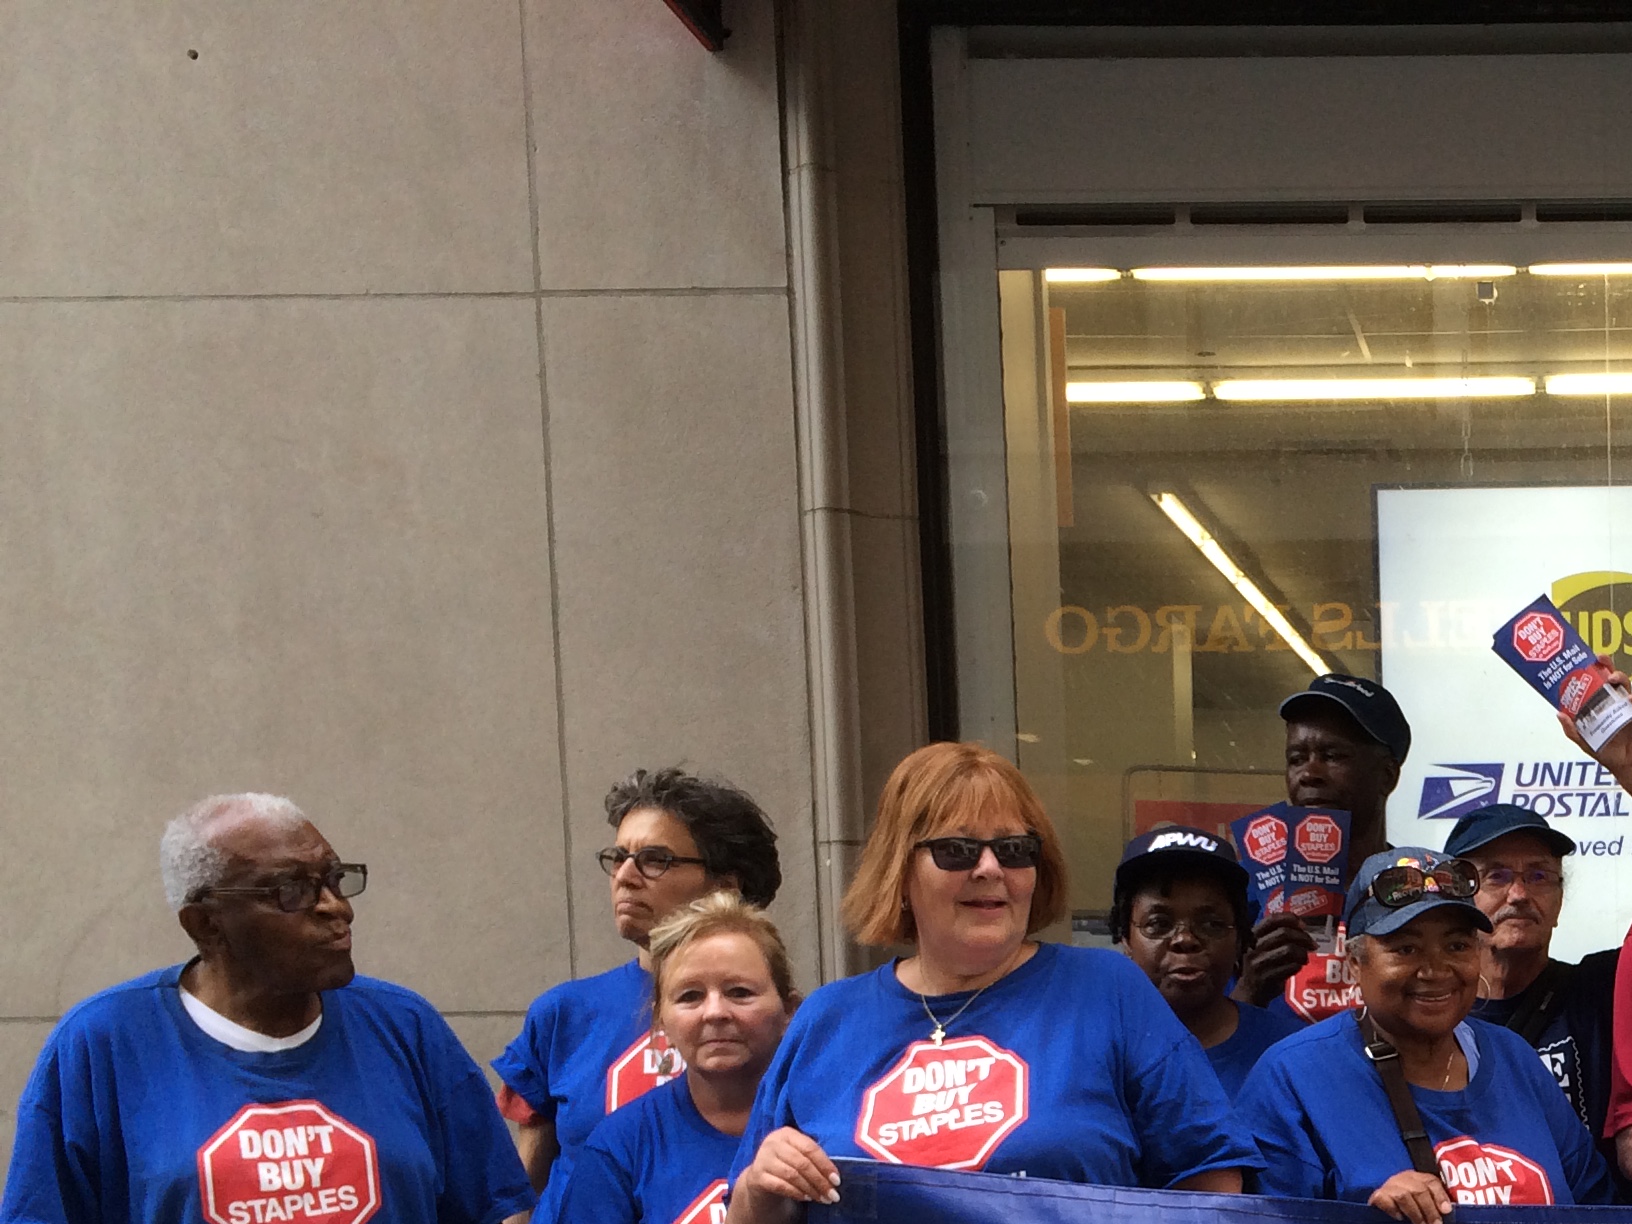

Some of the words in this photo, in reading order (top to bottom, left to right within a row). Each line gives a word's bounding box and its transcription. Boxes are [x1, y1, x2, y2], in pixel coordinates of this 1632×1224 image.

[1517, 616, 1544, 641] DON'T
[1528, 625, 1547, 645] BUY
[1528, 629, 1559, 659] STAPLES
[1538, 667, 1553, 681] The
[1550, 655, 1566, 671] U.S.
[1549, 667, 1565, 685] NOT
[1514, 761, 1618, 787] UNITE
[1510, 793, 1630, 818] POSTAL
[1252, 821, 1277, 838] DON'T
[1306, 821, 1333, 833] DON'T
[1309, 832, 1329, 843] BUY
[1147, 831, 1218, 853] APWU
[1258, 833, 1277, 847] BUY
[1300, 841, 1336, 852] STAPLES
[1255, 870, 1270, 881] The
[1290, 873, 1298, 882] Is
[1298, 873, 1315, 883] NOT
[1315, 875, 1325, 884] for
[1324, 875, 1340, 885] Sale
[1292, 863, 1307, 874] The
[1306, 864, 1321, 875] U.S.
[1323, 866, 1340, 876] Mail
[903, 1057, 996, 1094] DON'T
[912, 1083, 979, 1116] BUY
[878, 1101, 1005, 1146] STAPLES
[238, 1125, 334, 1160] DON'T
[258, 1158, 325, 1192] BUY
[1440, 1157, 1518, 1188] DON'T
